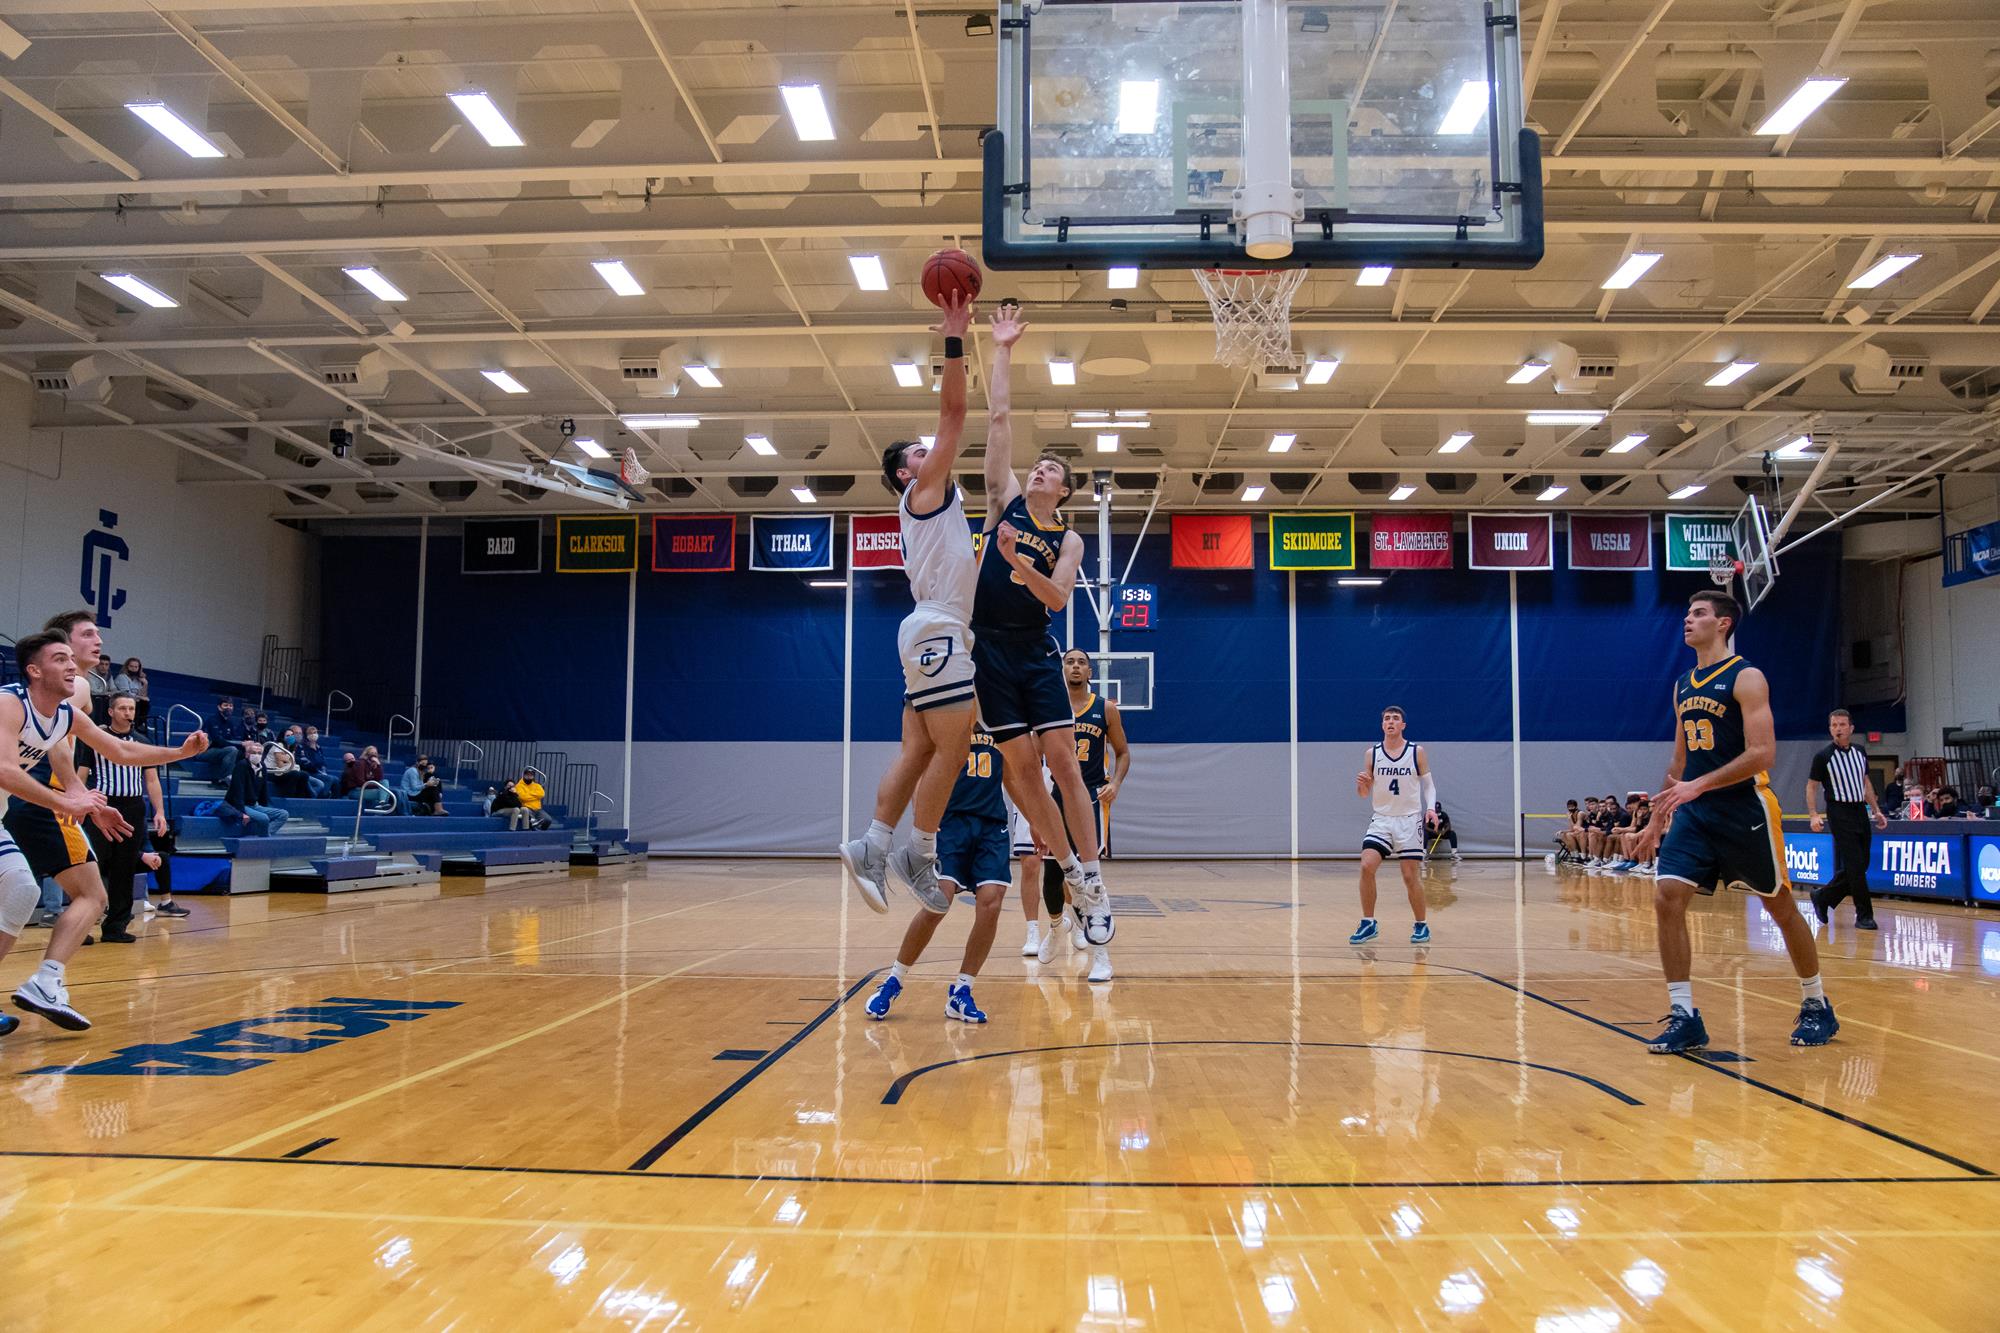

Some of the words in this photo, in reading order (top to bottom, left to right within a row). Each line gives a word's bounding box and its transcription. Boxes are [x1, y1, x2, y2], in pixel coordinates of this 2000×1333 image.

[1202, 532, 1221, 550] RIT
[1282, 532, 1342, 550] SKIDMORE
[1375, 532, 1392, 550] ST.
[1394, 532, 1448, 550] LAWRENCE
[1494, 532, 1528, 551] UNION
[1590, 533, 1631, 551] VASSAR
[1682, 524, 1732, 542] WILLIAM
[487, 537, 515, 555] BARD
[569, 535, 625, 553] CLARKSON
[672, 535, 715, 553] HOBART
[771, 534, 811, 552] ITHACA
[1689, 543, 1726, 561] SMITH
[1122, 589, 1152, 601] 15:36
[1122, 605, 1148, 627] 23
[1073, 722, 1103, 738] ESTER
[1684, 718, 1715, 752] 33
[967, 751, 992, 778] 10
[1377, 767, 1412, 776] ITHACA
[1388, 778, 1400, 796] 4
[1881, 840, 1951, 875] ITHACA
[1796, 870, 1819, 881] coaches
[1893, 873, 1937, 889] BOMBERS
